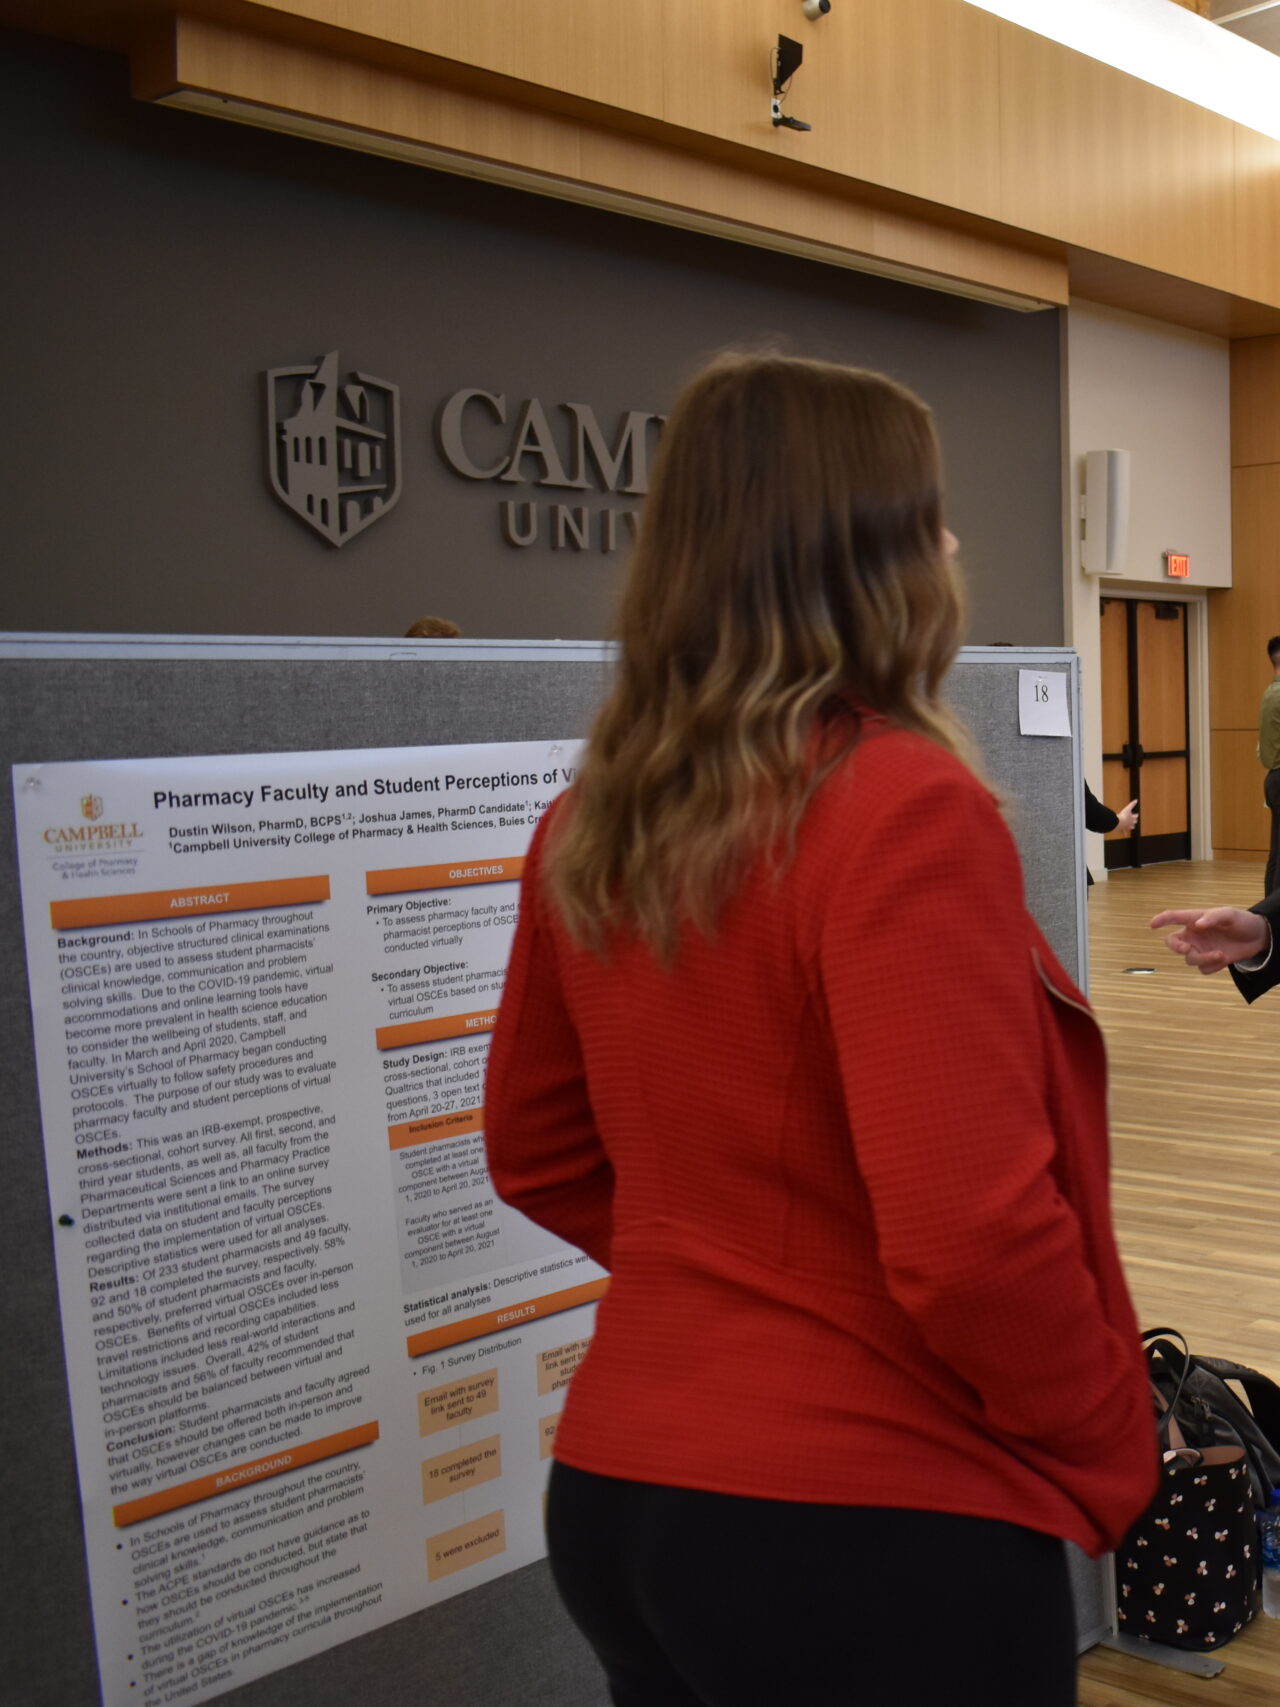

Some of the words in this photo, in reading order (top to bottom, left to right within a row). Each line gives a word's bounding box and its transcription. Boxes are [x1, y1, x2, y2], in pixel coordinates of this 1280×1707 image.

[434, 388, 667, 496] CAM
[1171, 557, 1187, 576] EXIT
[1034, 685, 1049, 703] 18
[153, 790, 254, 809] Pharmacy
[260, 783, 329, 803] Faculty
[335, 779, 368, 798] and
[373, 776, 440, 795] Student
[445, 771, 538, 792] Perceptions
[542, 768, 558, 784] of
[43, 823, 144, 844] CAMPBELL
[168, 825, 209, 838] Dustin
[211, 823, 255, 835] Wilson,
[258, 817, 307, 831] PharmD,
[358, 812, 397, 824] Joshua
[399, 810, 435, 821] James,
[437, 805, 476, 818] PharmD
[233, 835, 291, 849] University
[294, 832, 336, 844] College
[338, 829, 349, 840] of
[352, 827, 404, 839] Pharmacy
[406, 824, 414, 835] &
[417, 822, 448, 834] Health
[450, 820, 497, 831] Sciences,
[498, 816, 525, 827] Buies
[54, 840, 134, 853] UNIVERSITY
[449, 865, 504, 879] OBJECTIVES
[170, 892, 230, 908] ABSTRACT
[366, 904, 403, 916] Primary
[405, 898, 451, 912] Objective:
[382, 916, 394, 927] To
[395, 914, 426, 925] assess
[427, 909, 469, 923] pharmacy
[470, 904, 498, 916] faculty
[499, 902, 515, 913] and
[57, 930, 134, 949] Background:
[138, 930, 148, 940] In
[151, 924, 194, 938] Schools
[196, 922, 206, 933] of
[208, 918, 259, 932] Pharmacy
[262, 911, 314, 926] throughout
[383, 925, 431, 942] pharmacist
[432, 918, 482, 936] perceptions
[482, 917, 492, 927] of
[493, 914, 519, 926] OSCE
[58, 953, 77, 964] the
[80, 948, 124, 962] country,
[126, 942, 174, 958] objective
[177, 934, 228, 950] structured
[230, 929, 265, 944] clinical
[266, 924, 330, 940] examinations
[384, 938, 429, 954] conducted
[430, 935, 464, 947] virtually
[60, 963, 112, 981] (OSCEs)
[114, 962, 132, 973] are
[135, 956, 162, 970] used
[164, 956, 175, 967] to
[177, 952, 214, 965] assess
[216, 945, 253, 960] student
[371, 968, 421, 983] Secondary
[423, 961, 469, 975] Objective:
[386, 983, 398, 993] To
[400, 979, 431, 992] assess
[432, 973, 464, 987] student
[387, 994, 415, 1006] virtual
[416, 988, 449, 1002] OSCEs
[450, 984, 476, 997] based
[478, 984, 489, 992] on
[388, 1005, 434, 1020] curriculum
[465, 1015, 497, 1029] METHO
[382, 1057, 410, 1070] Study
[412, 1051, 447, 1064] Design:
[450, 1046, 466, 1057] IRB
[383, 1062, 451, 1083] cross-sectional,
[453, 1057, 480, 1070] cohort
[384, 1082, 424, 1096] Qualtrics
[425, 1077, 443, 1088] that
[444, 1069, 480, 1085] included
[386, 1094, 431, 1111] questions,
[433, 1090, 439, 1100] 3
[440, 1087, 462, 1100] open
[464, 1082, 480, 1094] text
[387, 1111, 408, 1122] from
[409, 1105, 429, 1118] April
[430, 1099, 458, 1114] 20-27,
[76, 1142, 133, 1160] Methods:
[136, 1137, 159, 1149] This
[162, 1132, 183, 1144] was
[186, 1129, 199, 1140] an
[201, 1115, 263, 1136] IRB-exempt,
[266, 1105, 323, 1126] prospective,
[403, 1292, 449, 1314] Statistical
[450, 1282, 491, 1300] analysis:
[493, 1269, 538, 1288] Descriptive
[540, 1259, 574, 1275] statistics
[404, 1312, 426, 1327] used
[427, 1310, 440, 1320] for
[441, 1304, 452, 1316] all
[454, 1295, 492, 1312] analyses
[497, 1304, 536, 1324] RESULTS
[440, 1360, 445, 1369] 1
[447, 1352, 476, 1367] Survey
[478, 1337, 522, 1358] Distribution
[215, 1455, 292, 1487] BACKGROUND
